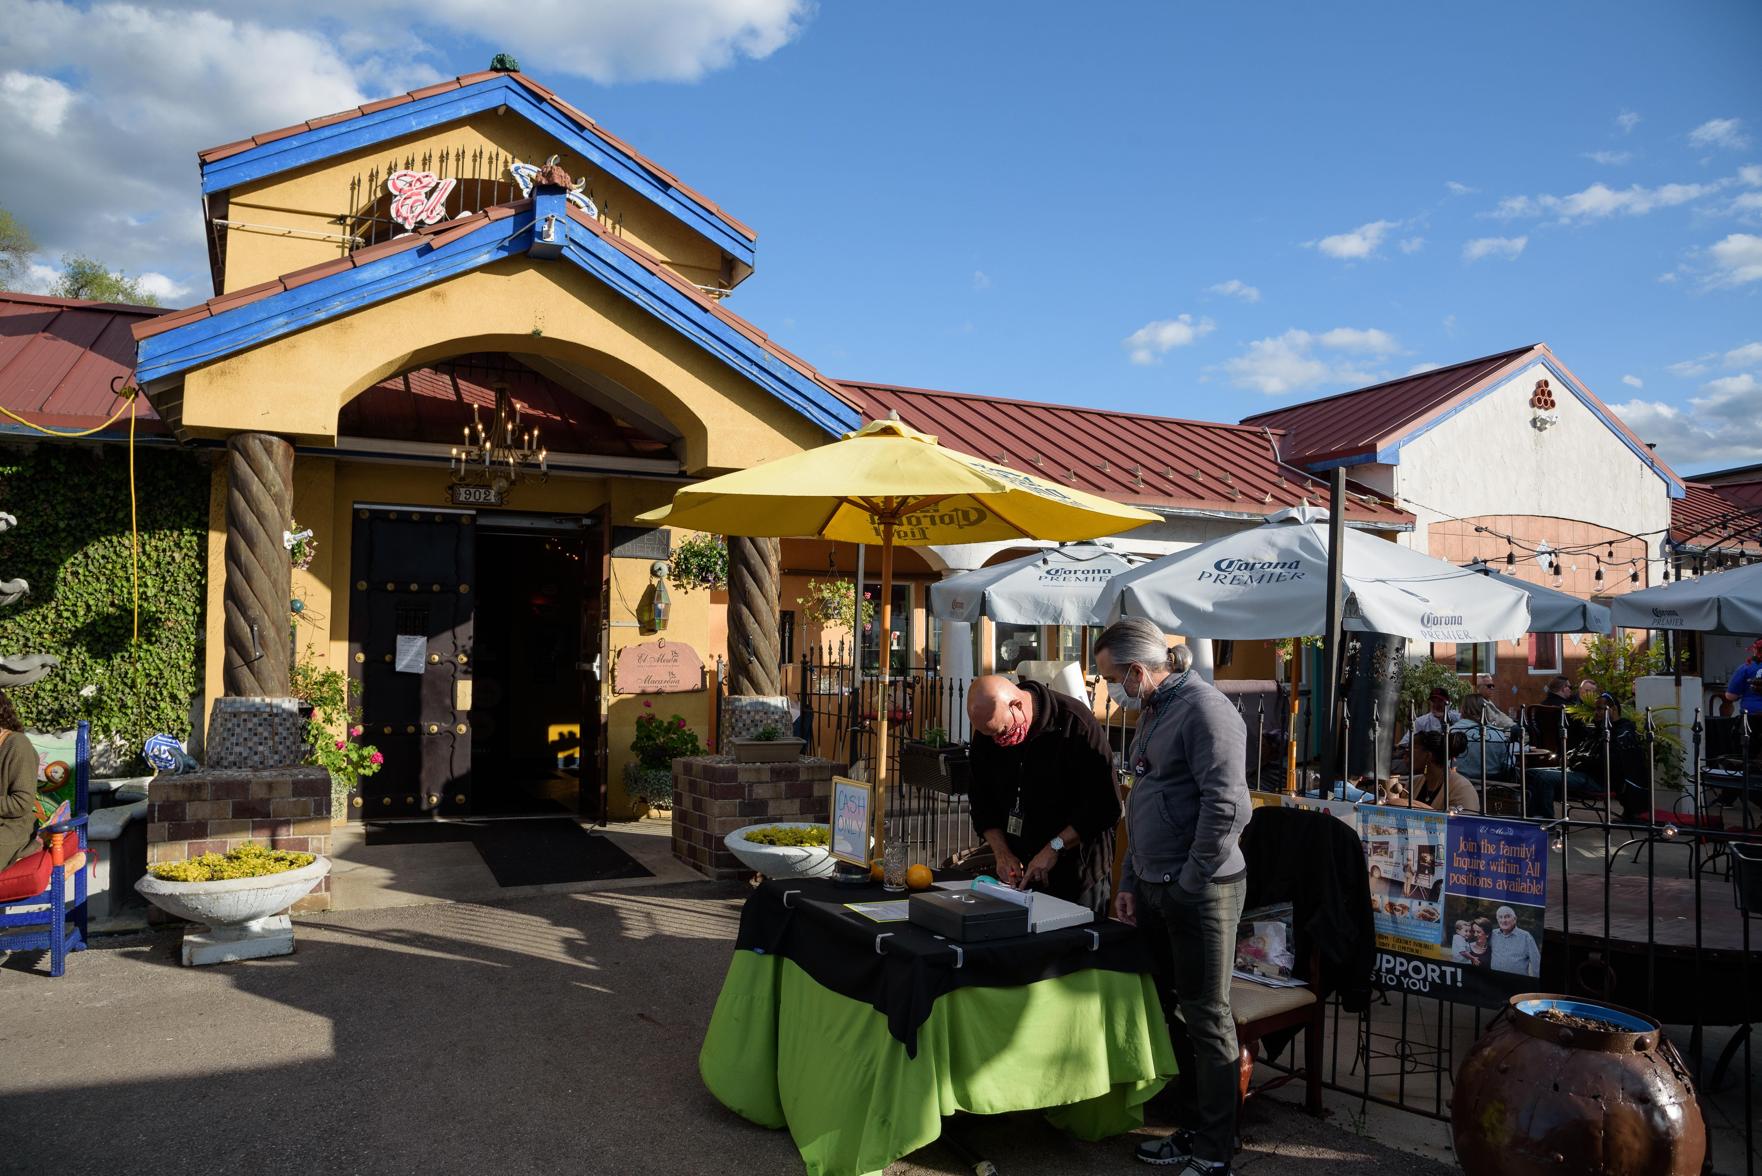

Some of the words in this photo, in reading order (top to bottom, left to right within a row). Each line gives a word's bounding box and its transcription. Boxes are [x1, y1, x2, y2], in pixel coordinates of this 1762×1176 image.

[387, 169, 457, 229] El
[464, 489, 491, 501] 902
[1046, 567, 1112, 577] Corona
[1214, 558, 1301, 575] Corona
[1198, 570, 1306, 586] PREMIER
[1420, 611, 1463, 630] Corona
[1420, 629, 1472, 640] PREMIER
[838, 790, 866, 816] CASH
[837, 815, 864, 838] ONLY
[1458, 836, 1477, 854] Join
[1480, 838, 1496, 854] the
[1499, 841, 1535, 862] family!
[1453, 852, 1486, 871] Inquire
[1489, 858, 1521, 875] within.
[1525, 861, 1540, 878] All
[1449, 872, 1493, 889] positions
[1496, 878, 1544, 896] available!
[1373, 952, 1463, 988] UPPORT!
[1379, 972, 1397, 985] TO
[1401, 976, 1430, 992] YOU
